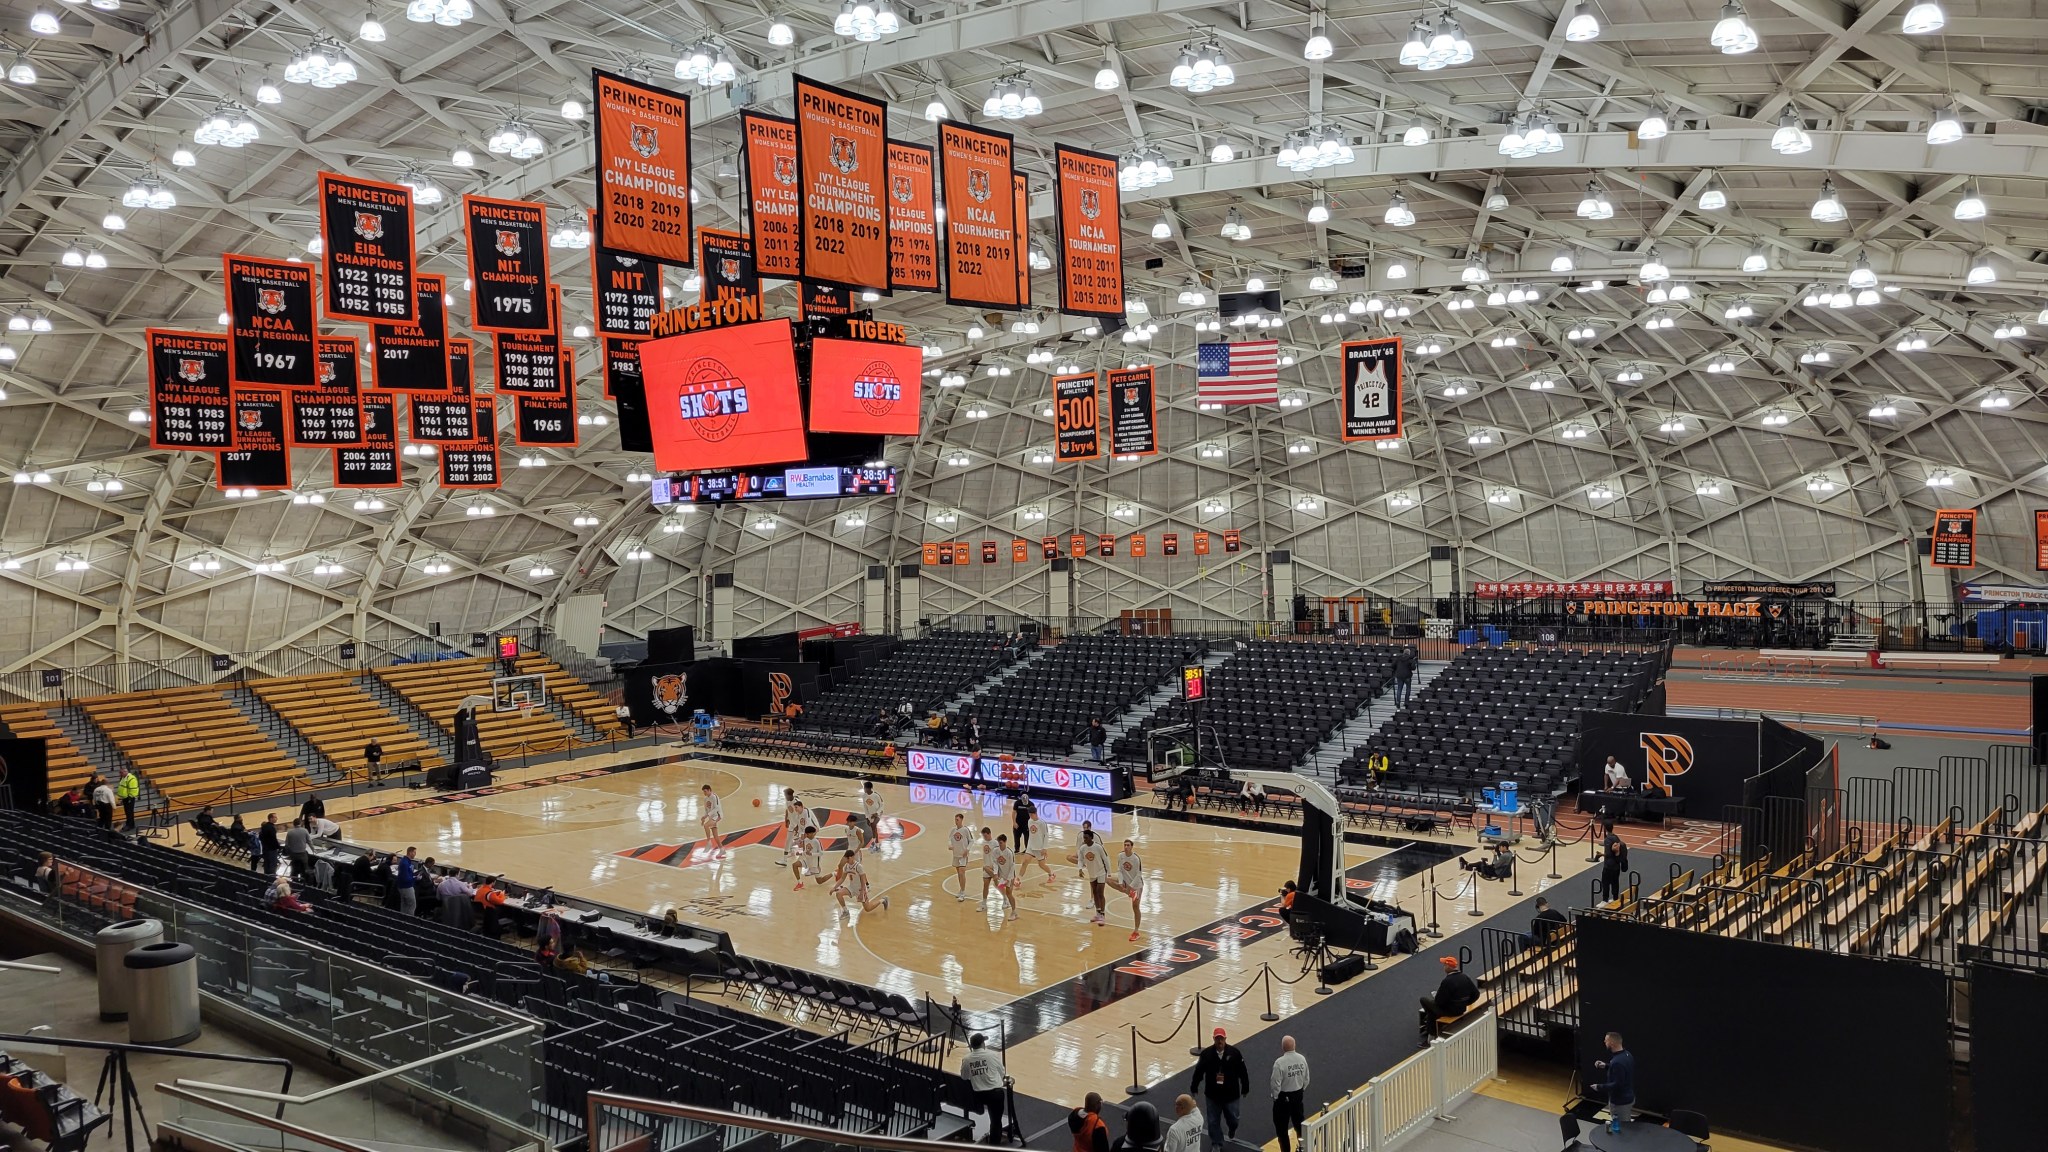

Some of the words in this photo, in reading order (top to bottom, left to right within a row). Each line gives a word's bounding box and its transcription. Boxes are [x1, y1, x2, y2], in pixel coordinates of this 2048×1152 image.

[603, 86, 682, 118] PRINCETON
[803, 93, 880, 127] PRINCETON
[640, 111, 679, 127] BASKETBALL
[945, 132, 1008, 158] PRINCETON
[614, 156, 631, 170] IVY
[635, 161, 675, 180] LEAGUE
[1062, 157, 1114, 178] PRINCETON
[605, 169, 685, 199] CHAMPIONS
[819, 172, 834, 184] IVY
[836, 176, 870, 193] LEAGUE
[1086, 176, 1113, 188] BASKETBALL
[328, 183, 406, 206] PRINCETON
[762, 187, 776, 199] IVY
[814, 183, 875, 206] TOURNAMENT
[613, 192, 644, 210] 2018
[651, 201, 680, 218] 2019
[808, 194, 881, 222] CHAMPIONS
[472, 205, 540, 222] PRINCETON
[966, 207, 996, 224] NCAA
[613, 211, 644, 228] 2020
[651, 219, 681, 236] 2022
[763, 220, 788, 234] 2006
[814, 215, 844, 234] 2018
[851, 222, 880, 241] 2019
[952, 222, 1011, 241] TOURNAMENT
[1079, 224, 1105, 240] NCAA
[355, 242, 385, 256] EIBL
[764, 237, 788, 251] 2011
[815, 235, 845, 255] 2022
[909, 238, 930, 251] 1976
[1068, 238, 1116, 255] TOURNAMENT
[956, 241, 981, 257] 2018
[986, 245, 1010, 262] 2019
[336, 253, 404, 271] CHAMPIONS
[497, 259, 521, 273] NIT
[765, 255, 790, 268] 2013
[910, 253, 931, 266] 1978
[1071, 256, 1092, 270] 2010
[1096, 258, 1115, 273] 2011
[233, 264, 308, 281] PRINCETON
[910, 268, 931, 281] 1999
[957, 260, 982, 276] 2022
[337, 267, 368, 282] 1922
[374, 272, 404, 286] 1925
[482, 272, 539, 284] CHAMPIONS
[612, 270, 644, 291] NIT
[1072, 273, 1093, 288] 2012
[1096, 275, 1117, 289] 2013
[338, 282, 369, 296] 1932
[375, 287, 404, 301] 1950
[1073, 290, 1094, 304] 2015
[1097, 291, 1118, 306] 2016
[493, 296, 532, 313] 1975
[605, 292, 628, 304] 1972
[632, 294, 655, 306] 1975
[339, 297, 370, 311] 1952
[375, 301, 405, 315] 1955
[605, 304, 629, 317] 1999
[650, 295, 757, 338] PRINCETON
[252, 316, 295, 331] NCAA
[606, 318, 630, 330] 2002
[262, 331, 310, 342] REGIONAL
[393, 326, 424, 337] NCAA
[847, 319, 907, 343] TIGERS
[155, 337, 226, 351] PRINCETON
[380, 336, 440, 347] TOURNAMENT
[501, 341, 555, 353] TOURNAMENT
[383, 349, 409, 359] 2017
[505, 353, 528, 364] 1996
[532, 355, 554, 366] 1997
[1348, 348, 1382, 359] BRADLEY
[254, 353, 296, 370] 1967
[505, 365, 529, 376] 1998
[532, 367, 554, 377] 2001
[506, 376, 530, 388] 2004
[533, 379, 554, 389] 2011
[1057, 378, 1094, 391] PRINCETON
[1111, 375, 1127, 384] PETE
[1128, 372, 1150, 382] CARRIL
[854, 382, 900, 400] SHOTS
[1063, 388, 1088, 396] ATHLETICS
[1357, 380, 1386, 392] PRINCETON
[157, 393, 229, 406] CHAMPIONS
[294, 395, 357, 405] CHAMPIONS
[680, 388, 748, 419] SHOTS
[1362, 392, 1380, 409] 42
[164, 406, 191, 417] 1981
[197, 408, 225, 418] 1983
[300, 407, 325, 417] 1967
[329, 407, 354, 417] 1968
[418, 405, 441, 414] 1959
[1058, 396, 1095, 431] 500
[164, 419, 192, 429] 1984
[198, 420, 225, 431] 1989
[301, 419, 326, 428] 1969
[331, 419, 355, 428] 1976
[420, 416, 441, 426] 1961
[533, 419, 562, 432] 1965
[1347, 420, 1375, 428] SULLIVAN
[1375, 419, 1396, 427] AWARD
[165, 431, 192, 441] 1990
[198, 433, 225, 442] 1991
[302, 430, 327, 440] 1977
[331, 431, 356, 440] 1980
[446, 427, 469, 437] 1965
[1377, 427, 1390, 435] 1965
[1071, 441, 1088, 454] Ivy
[227, 452, 251, 461] 2017
[369, 452, 391, 461] 2011
[344, 462, 366, 470] 2017
[370, 462, 392, 471] 2022
[863, 469, 886, 481] 38:51
[707, 478, 727, 489] 38:51
[750, 476, 758, 489] 0
[1747, 585, 1767, 593] TRACK
[1984, 589, 2020, 598] PRINCETON
[2022, 591, 2043, 600] TRACK
[1583, 601, 1689, 616] PRINCETON
[1694, 601, 1761, 617] TRACK
[1336, 628, 1349, 636] 107
[1541, 633, 1555, 642] 108
[502, 643, 517, 657] 30
[215, 659, 228, 667] 102
[45, 674, 60, 683] 101
[1185, 668, 1202, 680] 38:51
[1187, 678, 1202, 698] 30
[927, 756, 955, 773] PNC
[1072, 773, 1105, 791] PNC
[969, 1059, 988, 1069] PUBLIC
[1288, 1063, 1304, 1071] PUBLIC
[970, 1068, 989, 1077] SAFETY
[1185, 1124, 1202, 1138] PUBLIC
